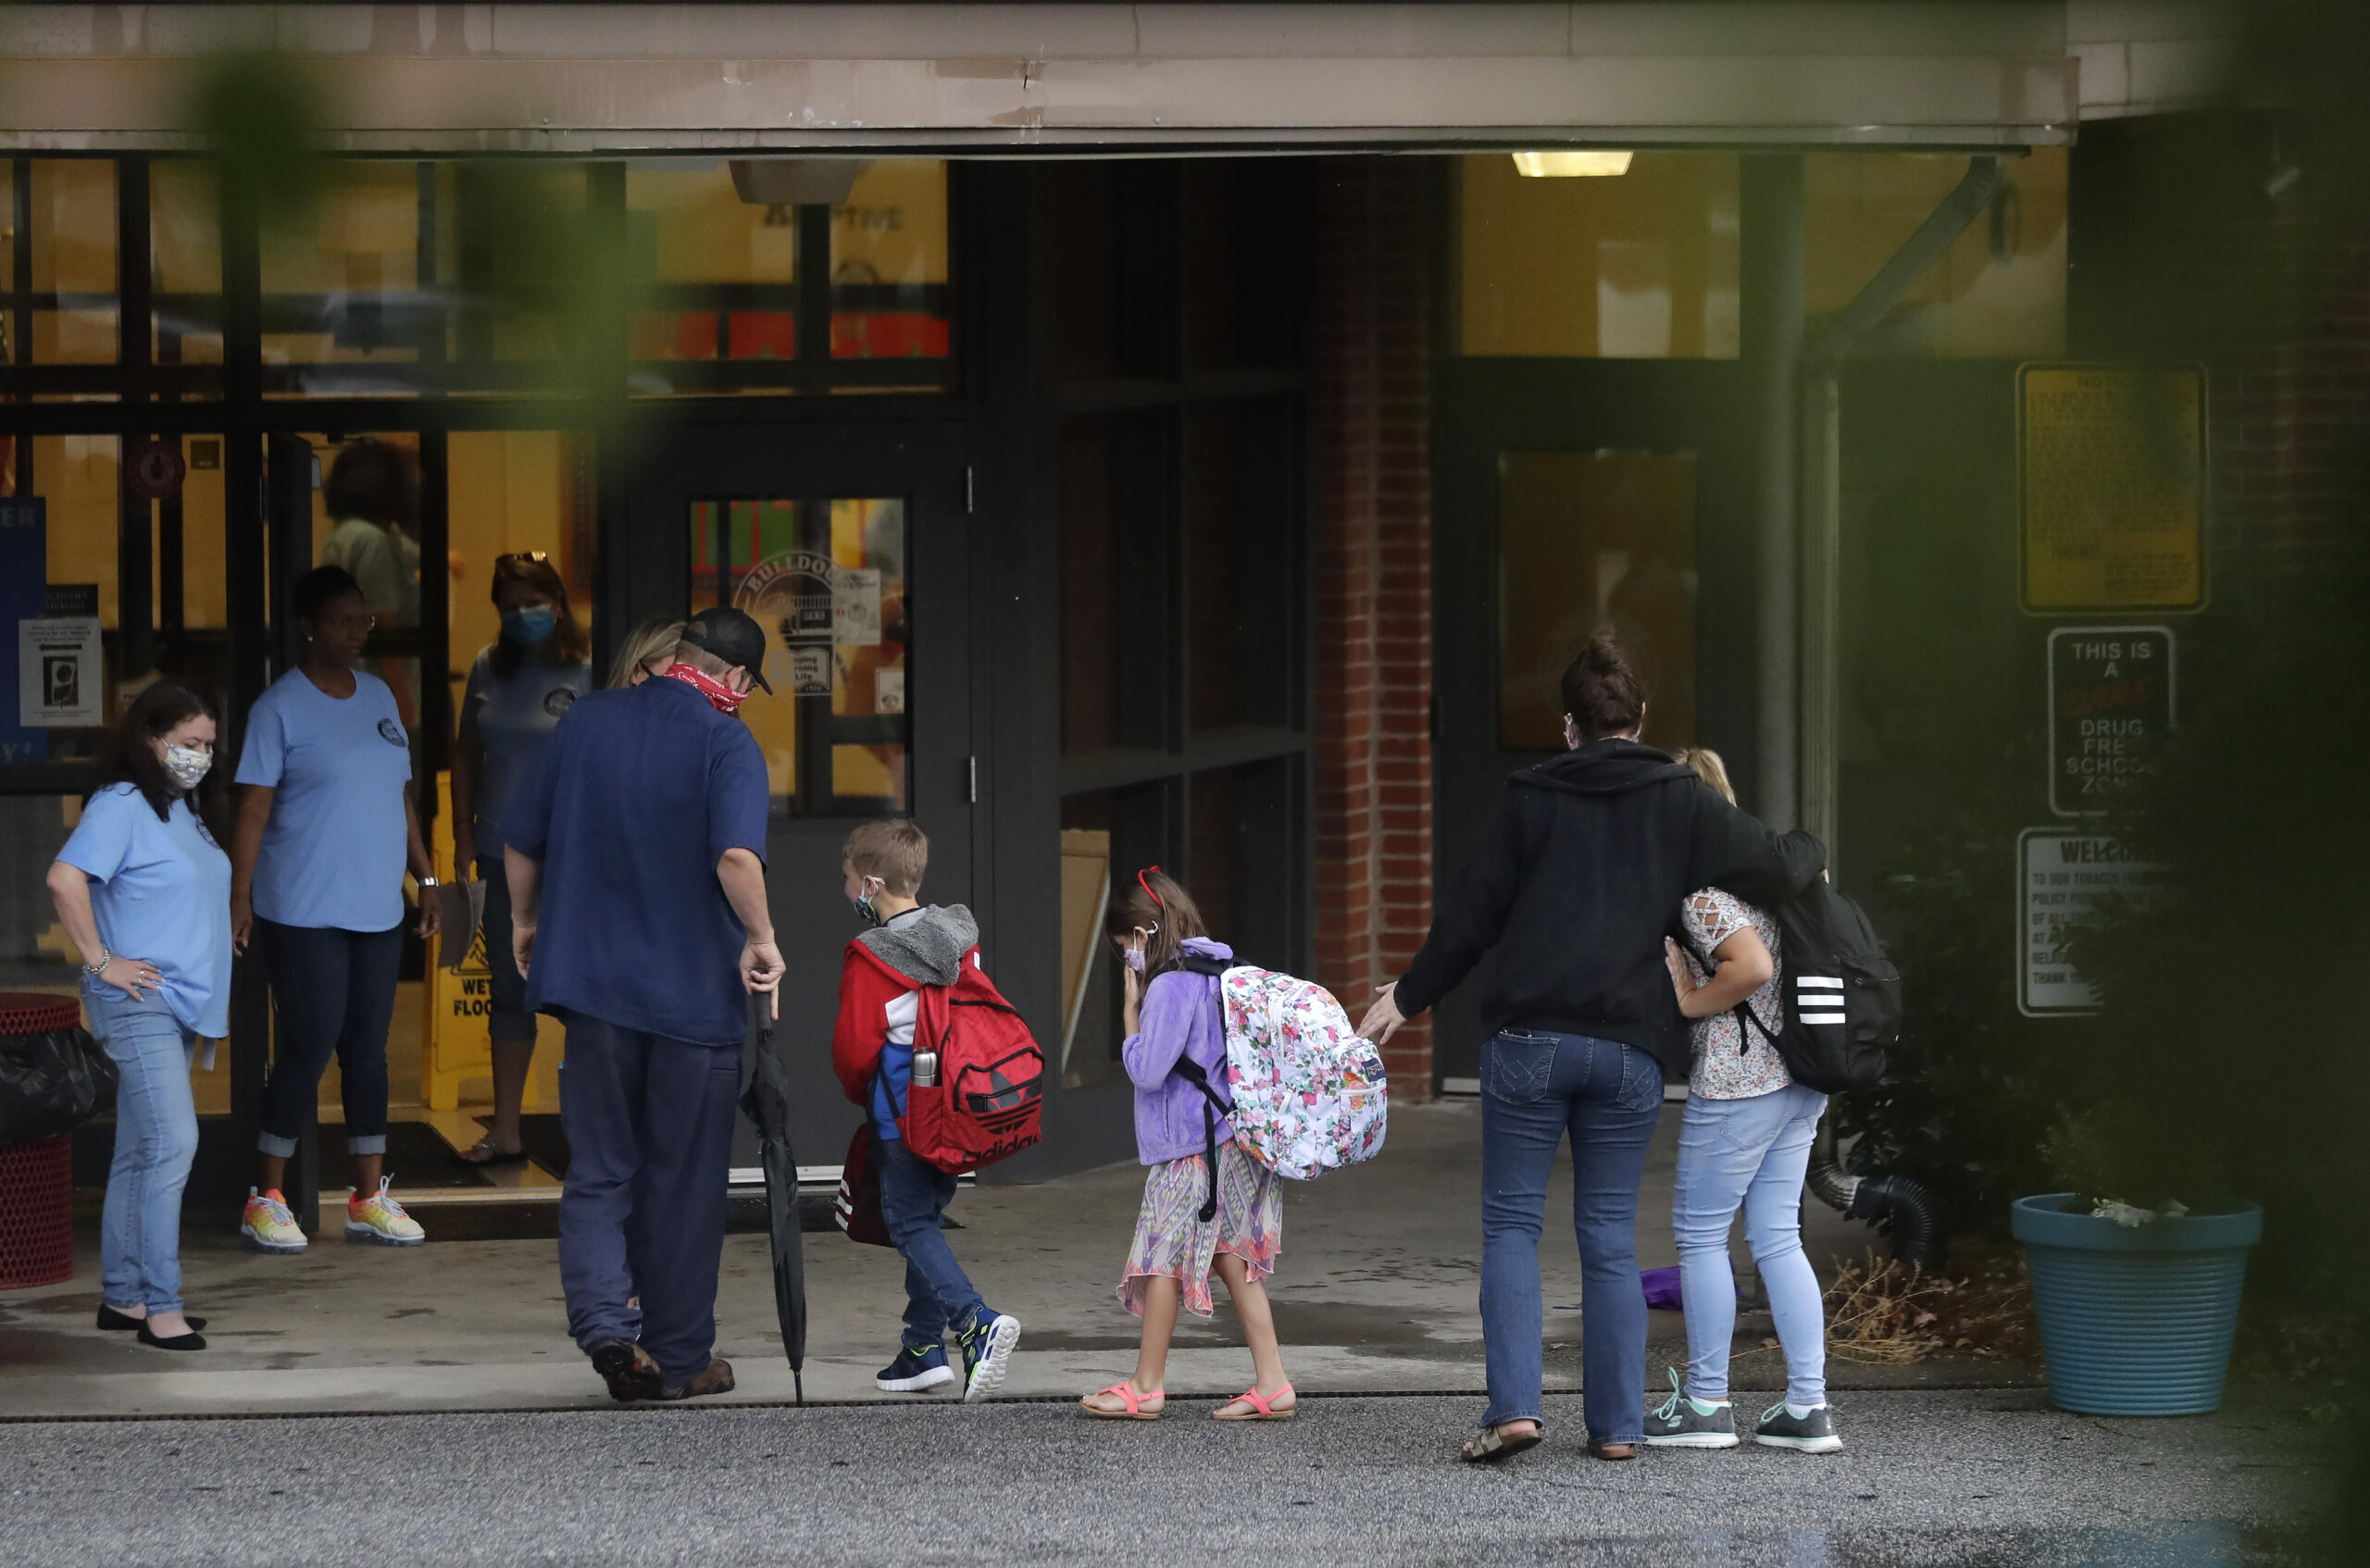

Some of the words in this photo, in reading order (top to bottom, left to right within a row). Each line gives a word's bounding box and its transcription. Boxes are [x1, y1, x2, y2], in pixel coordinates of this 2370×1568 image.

[2072, 643, 2121, 659] THIS
[2130, 642, 2152, 659] IS
[2103, 662, 2118, 678] A
[2080, 719, 2144, 736] DRUG
[2083, 738, 2126, 754] FRE
[2081, 776, 2134, 793] ZON
[454, 999, 493, 1016] FLOO
